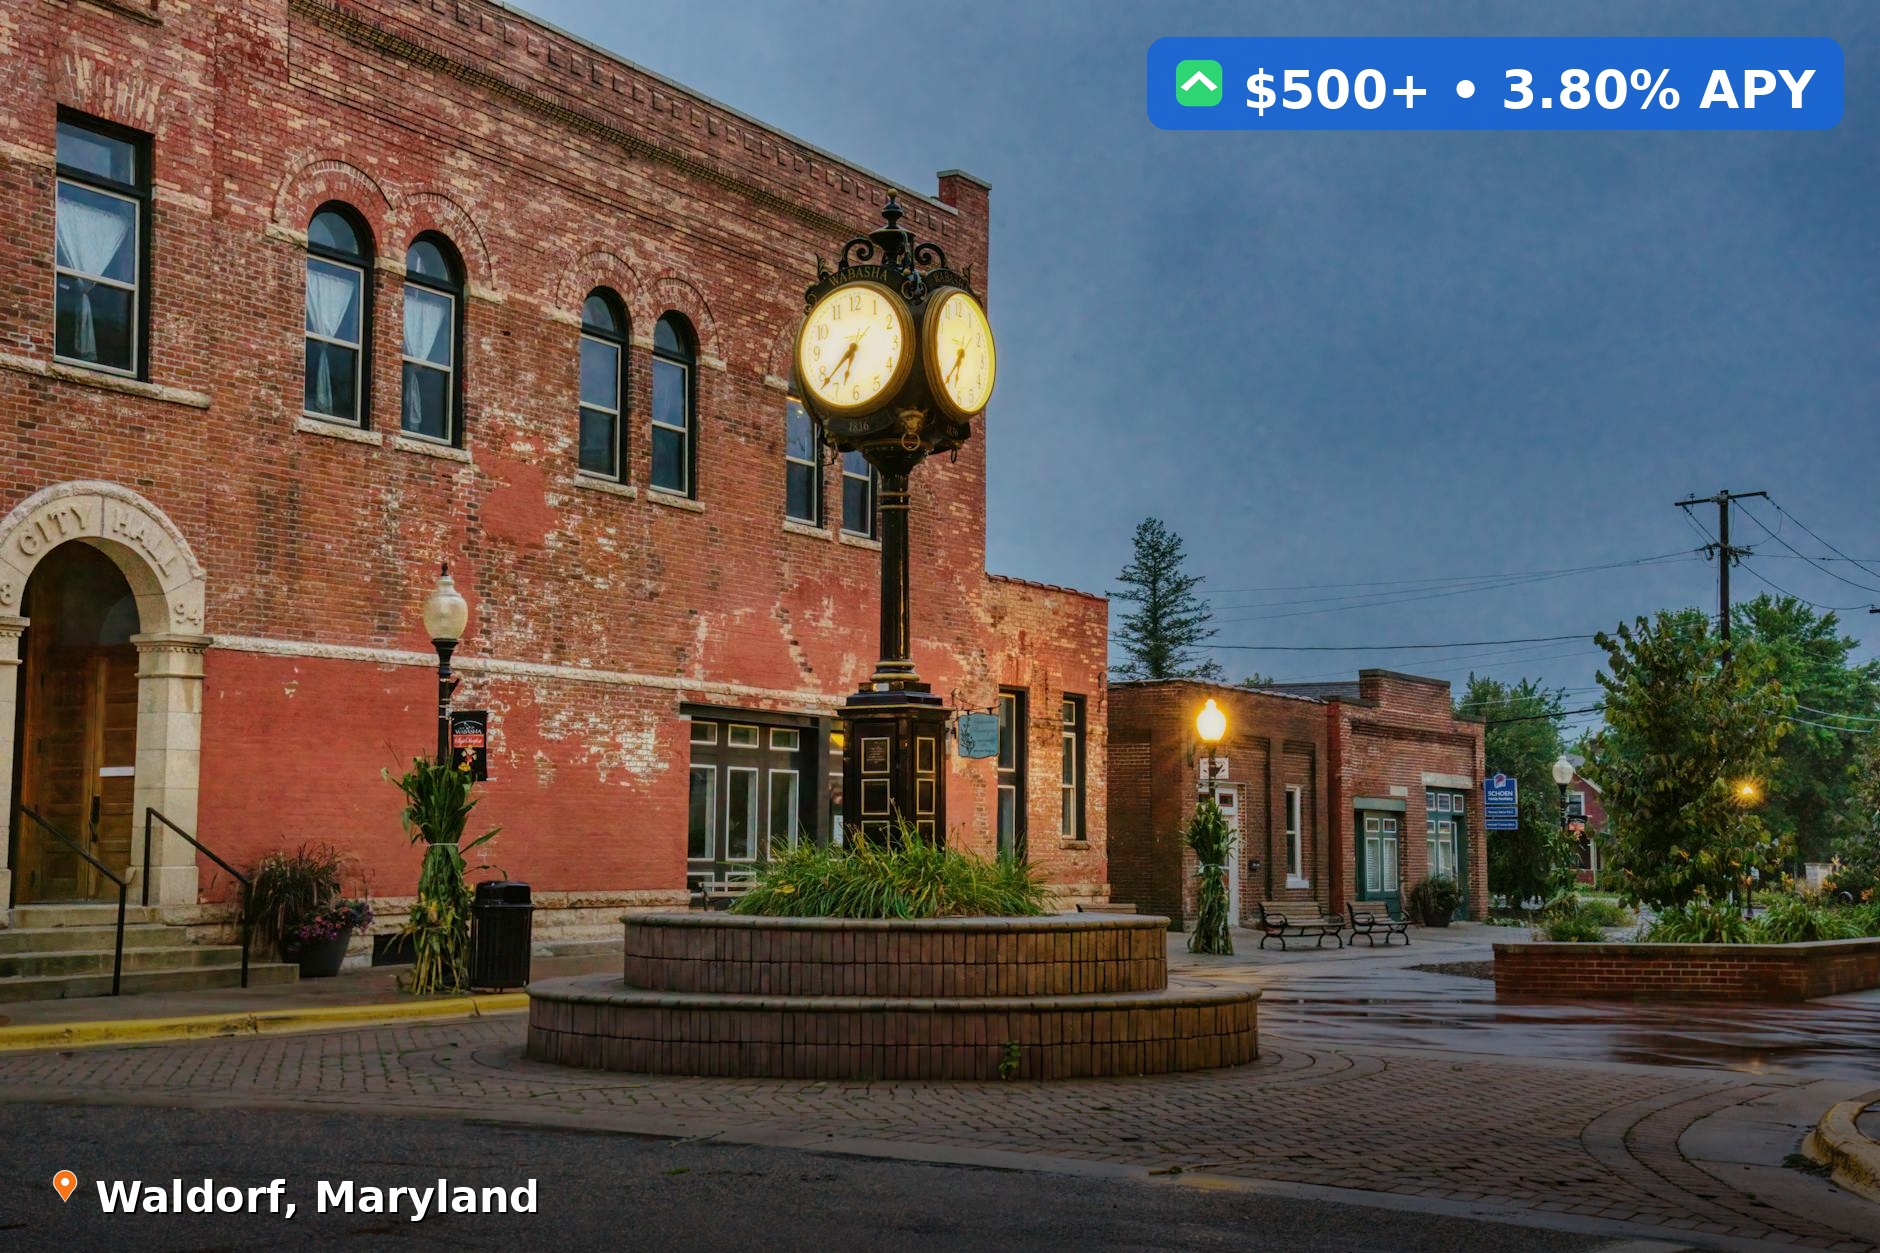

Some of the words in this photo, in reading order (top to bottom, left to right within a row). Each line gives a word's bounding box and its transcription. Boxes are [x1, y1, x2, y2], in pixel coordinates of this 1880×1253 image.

[829, 267, 888, 287] WABASHA
[850, 296, 861, 312] 12
[872, 300, 877, 315] 1
[832, 305, 841, 320] 11
[885, 314, 893, 330] 2
[817, 324, 829, 340] 10
[892, 335, 898, 350] 3
[813, 347, 821, 361] 9
[885, 356, 892, 373] 4
[833, 382, 840, 398] 7
[873, 375, 880, 392] 5
[853, 385, 860, 400] 6
[18, 505, 92, 556] CITY
[112, 508, 177, 578] HALL
